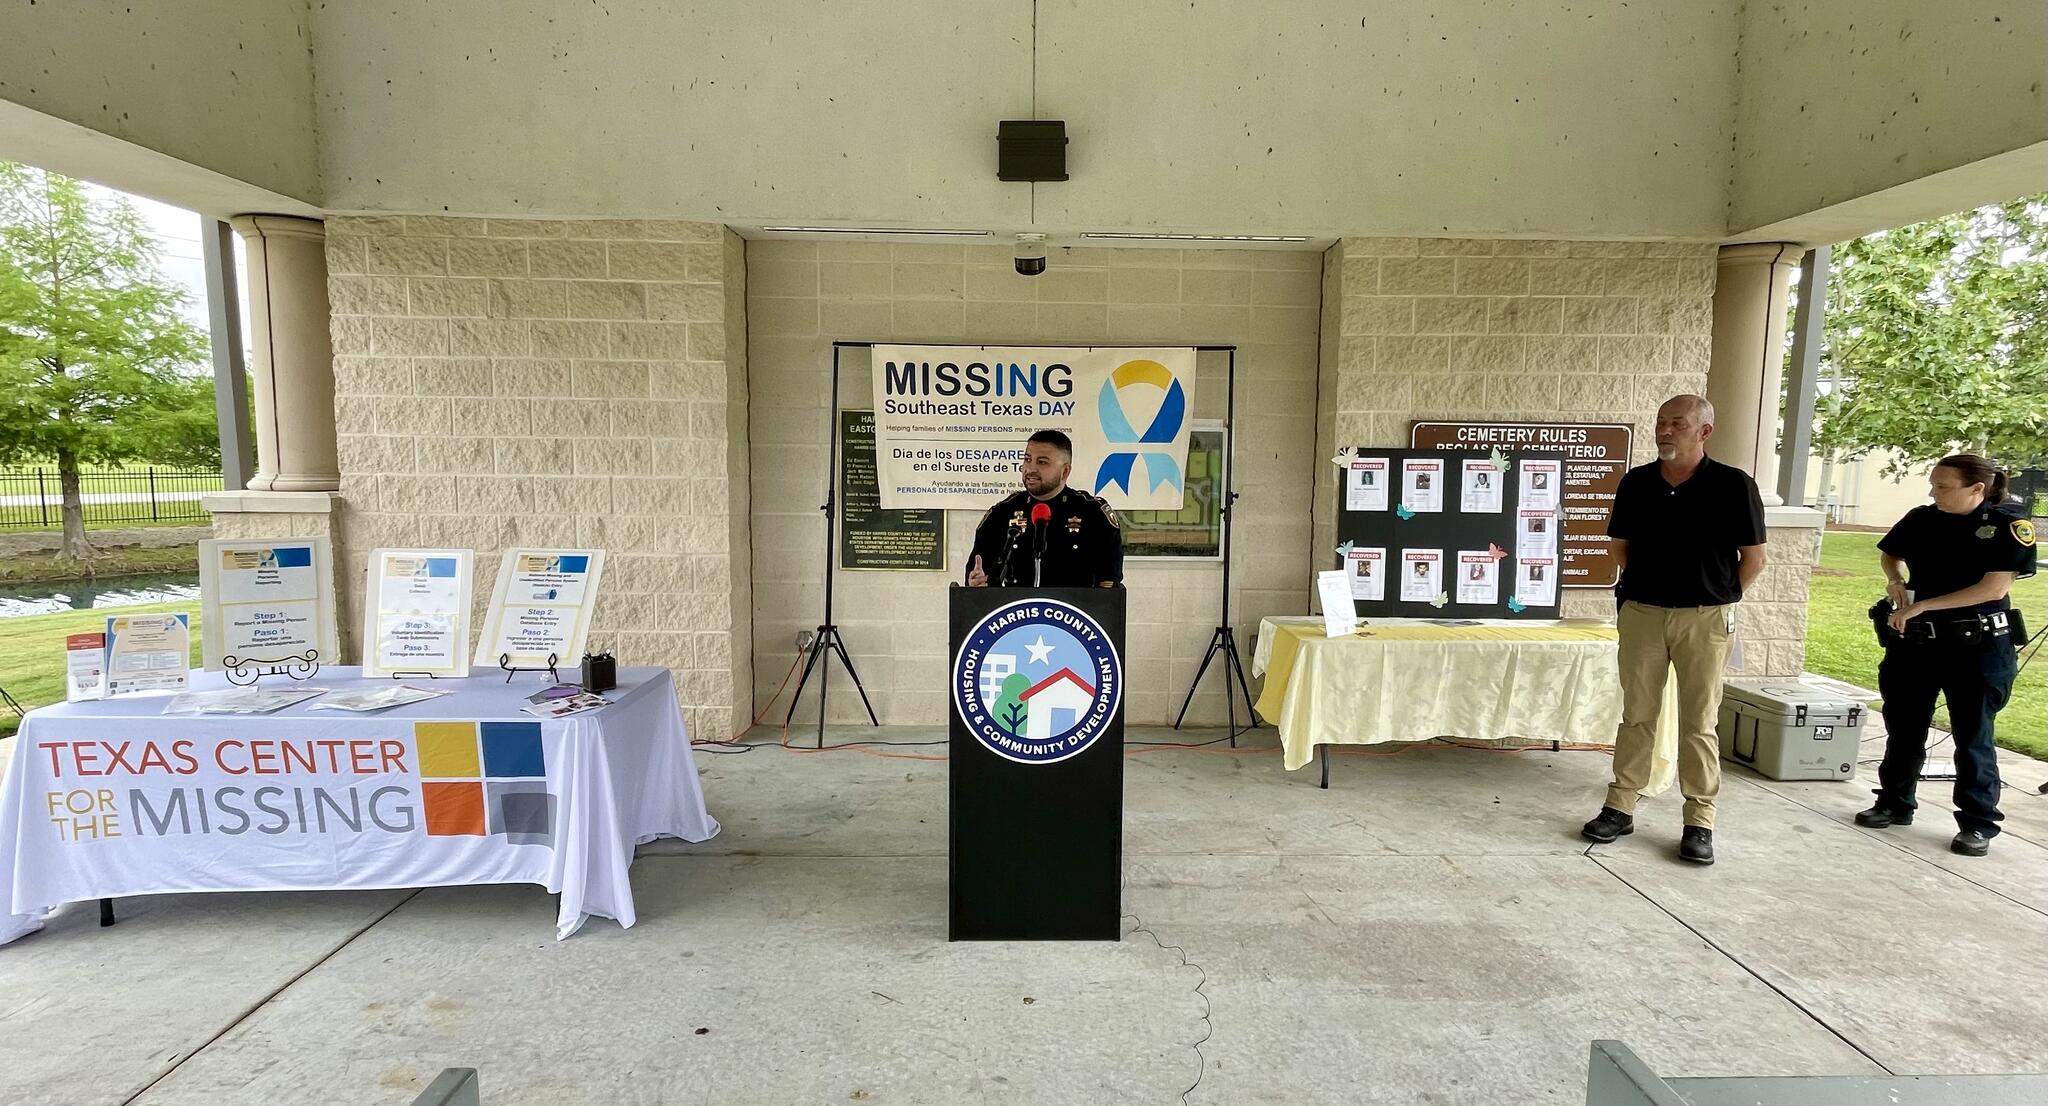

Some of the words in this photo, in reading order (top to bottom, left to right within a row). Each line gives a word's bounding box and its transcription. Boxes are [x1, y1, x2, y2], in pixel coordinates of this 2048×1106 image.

[885, 361, 1073, 397] MISSING
[885, 399, 976, 416] Southeast
[981, 400, 1033, 416] Texas
[1039, 401, 1076, 416] DAY
[1457, 427, 1536, 443] CEMETERY
[1539, 429, 1587, 443] RULES
[893, 448, 913, 459] Dia
[916, 449, 932, 459] de
[935, 449, 952, 459] los
[956, 449, 1025, 460] DESAPARE
[913, 463, 928, 471] en
[931, 461, 941, 471] el
[944, 461, 990, 473] Sureste
[993, 462, 1008, 473] de
[1011, 462, 1024, 473] Te
[939, 487, 999, 495] DESAPARECIDAS
[254, 612, 276, 620] Step
[527, 608, 546, 616] Step
[405, 621, 423, 629] Step
[423, 621, 431, 629] 3:
[988, 607, 1040, 634] HARRIS
[1043, 607, 1098, 642] COUNTY
[254, 629, 278, 637] Paso
[963, 648, 981, 713] HOUSING
[974, 715, 985, 726] &
[983, 724, 1066, 755] COMMUNITY
[1067, 656, 1112, 747] DEVELOPMENT
[38, 739, 199, 778] TEXAS
[214, 739, 409, 775] CENTER
[46, 788, 118, 816] FOR
[129, 785, 416, 836] MISSING
[51, 813, 123, 841] THE
